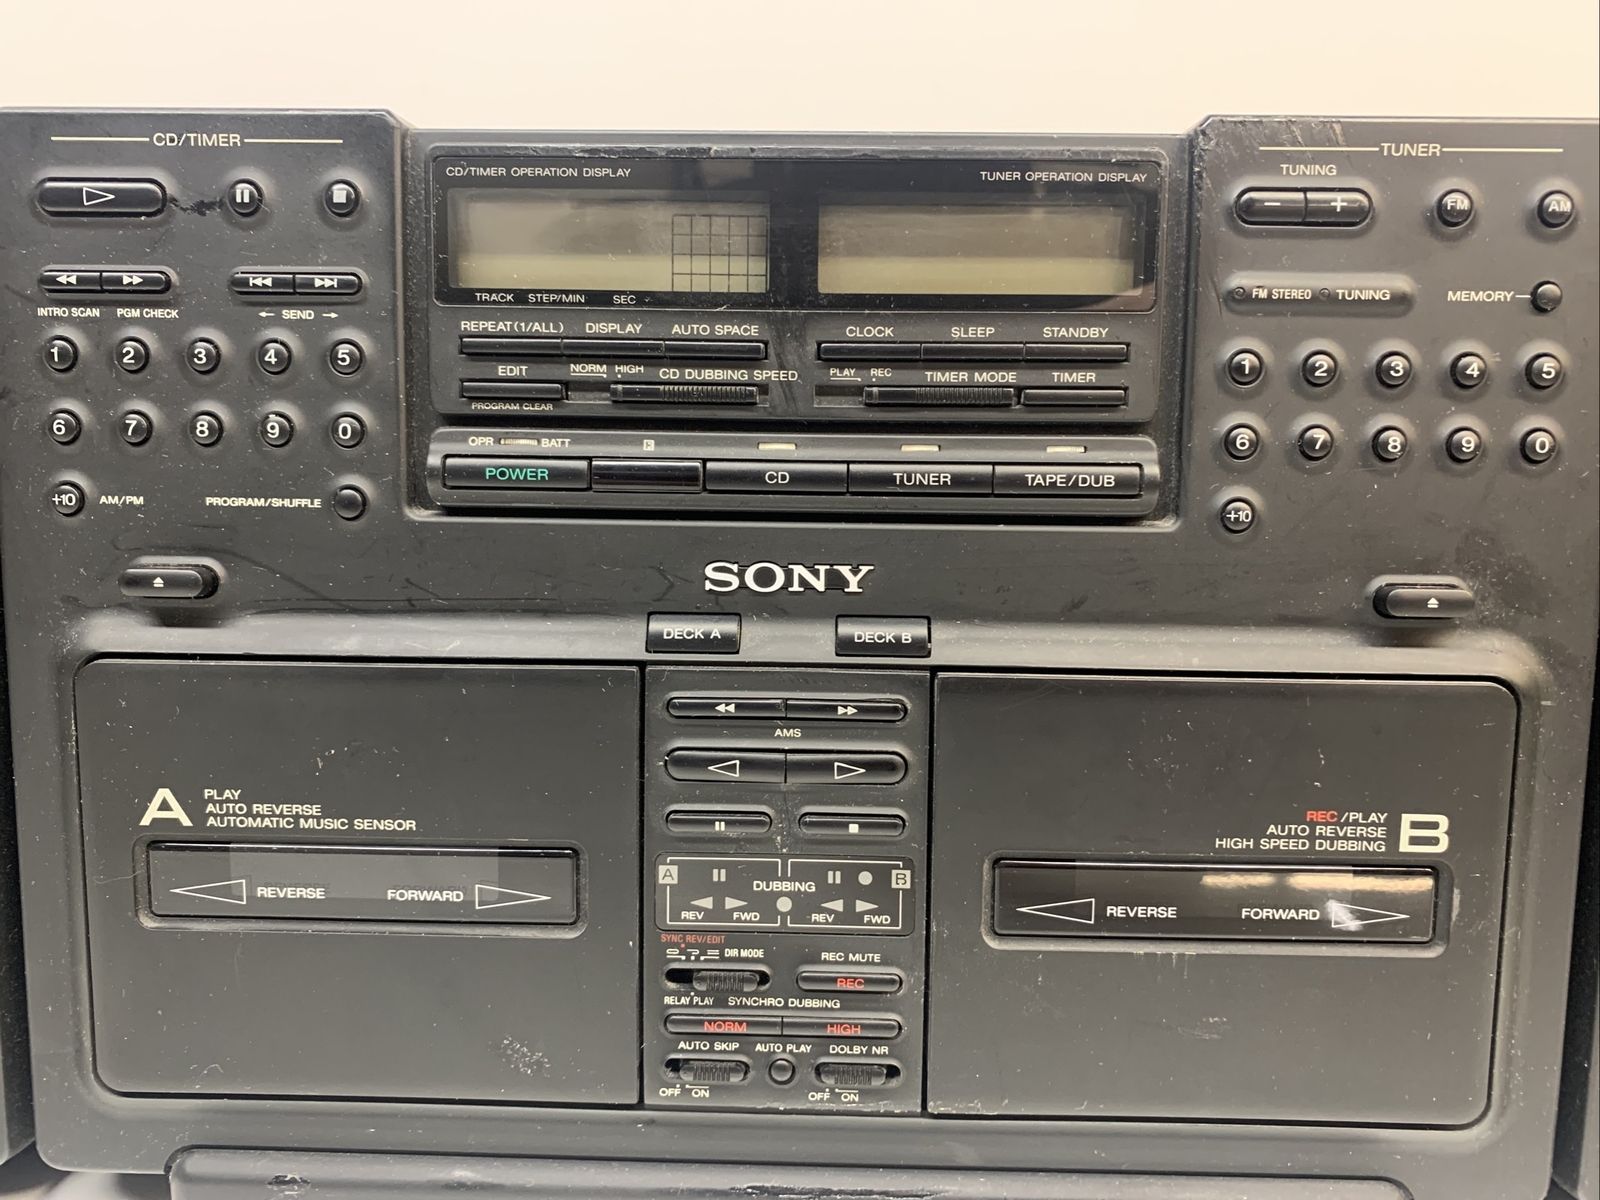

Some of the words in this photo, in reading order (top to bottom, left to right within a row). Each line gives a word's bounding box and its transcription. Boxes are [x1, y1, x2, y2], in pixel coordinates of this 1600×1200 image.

[153, 133, 241, 147] CD/TIMER
[1381, 143, 1441, 157] TUNER
[446, 167, 506, 177] CD/TIMER
[511, 167, 578, 177] OPERATION
[583, 168, 631, 178] DISPLAY
[1280, 164, 1337, 176] TUNING
[980, 171, 1020, 181] TUNER
[1025, 172, 1093, 182] OPERATION
[1098, 172, 1147, 183] DISPLAY
[1447, 199, 1468, 211] FM
[1548, 201, 1571, 212] AM
[475, 293, 514, 302] TRACK
[528, 293, 585, 303] STEP/MIN
[613, 294, 636, 304] SEC
[1252, 288, 1267, 299] FM
[1272, 289, 1311, 300] STEREO
[1336, 290, 1390, 300] TUNING
[1447, 291, 1514, 302] MEMORY
[37, 307, 68, 317] INTRO
[71, 308, 100, 318] SCAN
[117, 308, 140, 318] PGM
[142, 309, 179, 319] CHECK
[282, 309, 314, 320] SEND
[461, 320, 564, 334] REPEAT(1/ALL)
[585, 323, 642, 334] DISPLAY
[672, 325, 710, 336] AUTO
[714, 325, 759, 336] SPACE
[846, 326, 894, 338] CLOCK
[951, 326, 995, 338] SLEEP
[1043, 327, 1109, 338] STANDBY
[51, 348, 59, 362] 1
[122, 348, 135, 363] 2
[193, 349, 207, 364] 3
[264, 349, 278, 364] 4
[337, 350, 350, 365] 5
[498, 366, 528, 377] EDIT
[570, 363, 607, 373] NORM
[615, 363, 644, 374] HIGH
[830, 367, 856, 377] PLAY
[871, 368, 892, 377] REC
[1241, 361, 1250, 375] 1
[1314, 361, 1328, 377] 2
[1390, 361, 1404, 377] 3
[1465, 363, 1480, 378] 4
[1542, 363, 1556, 379] 5
[659, 368, 680, 380] CD
[685, 369, 749, 380] DUBBING
[754, 370, 798, 381] SPEED
[925, 371, 968, 382] TIMER
[974, 371, 1017, 383] MODE
[1052, 372, 1096, 383] TIMER
[472, 402, 520, 411] PROGRAM
[523, 403, 553, 411] CLEAR
[53, 420, 66, 435] 6
[125, 420, 138, 435] 7
[196, 421, 209, 437] 8
[267, 423, 280, 438] 9
[338, 423, 352, 439] 0
[468, 437, 494, 447] OPR
[541, 438, 571, 448] BATT
[1235, 434, 1249, 449] 6
[1313, 434, 1326, 449] 7
[1387, 437, 1401, 452] 8
[1461, 437, 1475, 452] 9
[1535, 437, 1549, 453] 0
[485, 468, 549, 480] POWER
[765, 471, 790, 484] CD
[893, 473, 951, 486] TUNER
[1025, 473, 1115, 487] TAPE/DUB
[52, 493, 76, 506] +10
[99, 495, 144, 505] AM/PM
[206, 497, 322, 508] PROGRAM/SHUFFLE
[1226, 510, 1251, 522] +10
[704, 562, 874, 592] SONY
[663, 629, 704, 639] DECK
[710, 629, 721, 639] A
[854, 632, 895, 643] DECK
[901, 633, 912, 643] B
[774, 728, 802, 737] AMS
[205, 789, 241, 800] PLAY
[139, 788, 193, 826] A
[205, 803, 247, 815] AUTO
[252, 804, 321, 816] REVERSE
[206, 817, 294, 829] AUTOMATIC
[299, 817, 348, 830] MUSIC
[353, 818, 416, 831] SENSOR
[1266, 825, 1309, 836] AUTO
[1315, 825, 1387, 838] REVERSE
[1399, 813, 1449, 853] B
[1215, 837, 1253, 850] HIGH
[1260, 838, 1309, 851] SPEED
[1315, 839, 1386, 852] DUBBING
[661, 868, 675, 881] A
[895, 873, 908, 886] B
[753, 881, 816, 892] DUBBING
[257, 887, 325, 899] REVERSE
[387, 889, 464, 902] FORWARD
[681, 911, 704, 920] REV
[733, 912, 760, 921] FWD
[811, 913, 835, 923] REV
[1106, 906, 1177, 919] REVERSE
[1241, 907, 1321, 921] FORWARD
[864, 915, 891, 924] FWD
[661, 934, 683, 943] SYNC
[686, 935, 726, 944] REV/EDIT
[724, 948, 739, 957] DIR
[740, 949, 764, 958] MODE
[821, 952, 844, 961] REC
[849, 953, 881, 962] MUTE
[837, 978, 865, 988] REC
[664, 996, 690, 1005] RELAY
[693, 996, 714, 1006] PLAY
[728, 997, 784, 1007] SYNCHRO
[788, 998, 840, 1008] DUBBING
[704, 1021, 747, 1032] NORM
[827, 1024, 861, 1034] HIGH
[678, 1041, 710, 1050] AUTO
[714, 1041, 739, 1051] SKIP
[755, 1043, 783, 1052] AUTO
[786, 1044, 812, 1053] PLAY
[829, 1045, 868, 1054] DOLBY
[872, 1045, 888, 1055] NR
[659, 1088, 681, 1096] OFF
[692, 1088, 709, 1098] ON
[808, 1092, 830, 1101] OFF
[841, 1093, 859, 1102] ON
